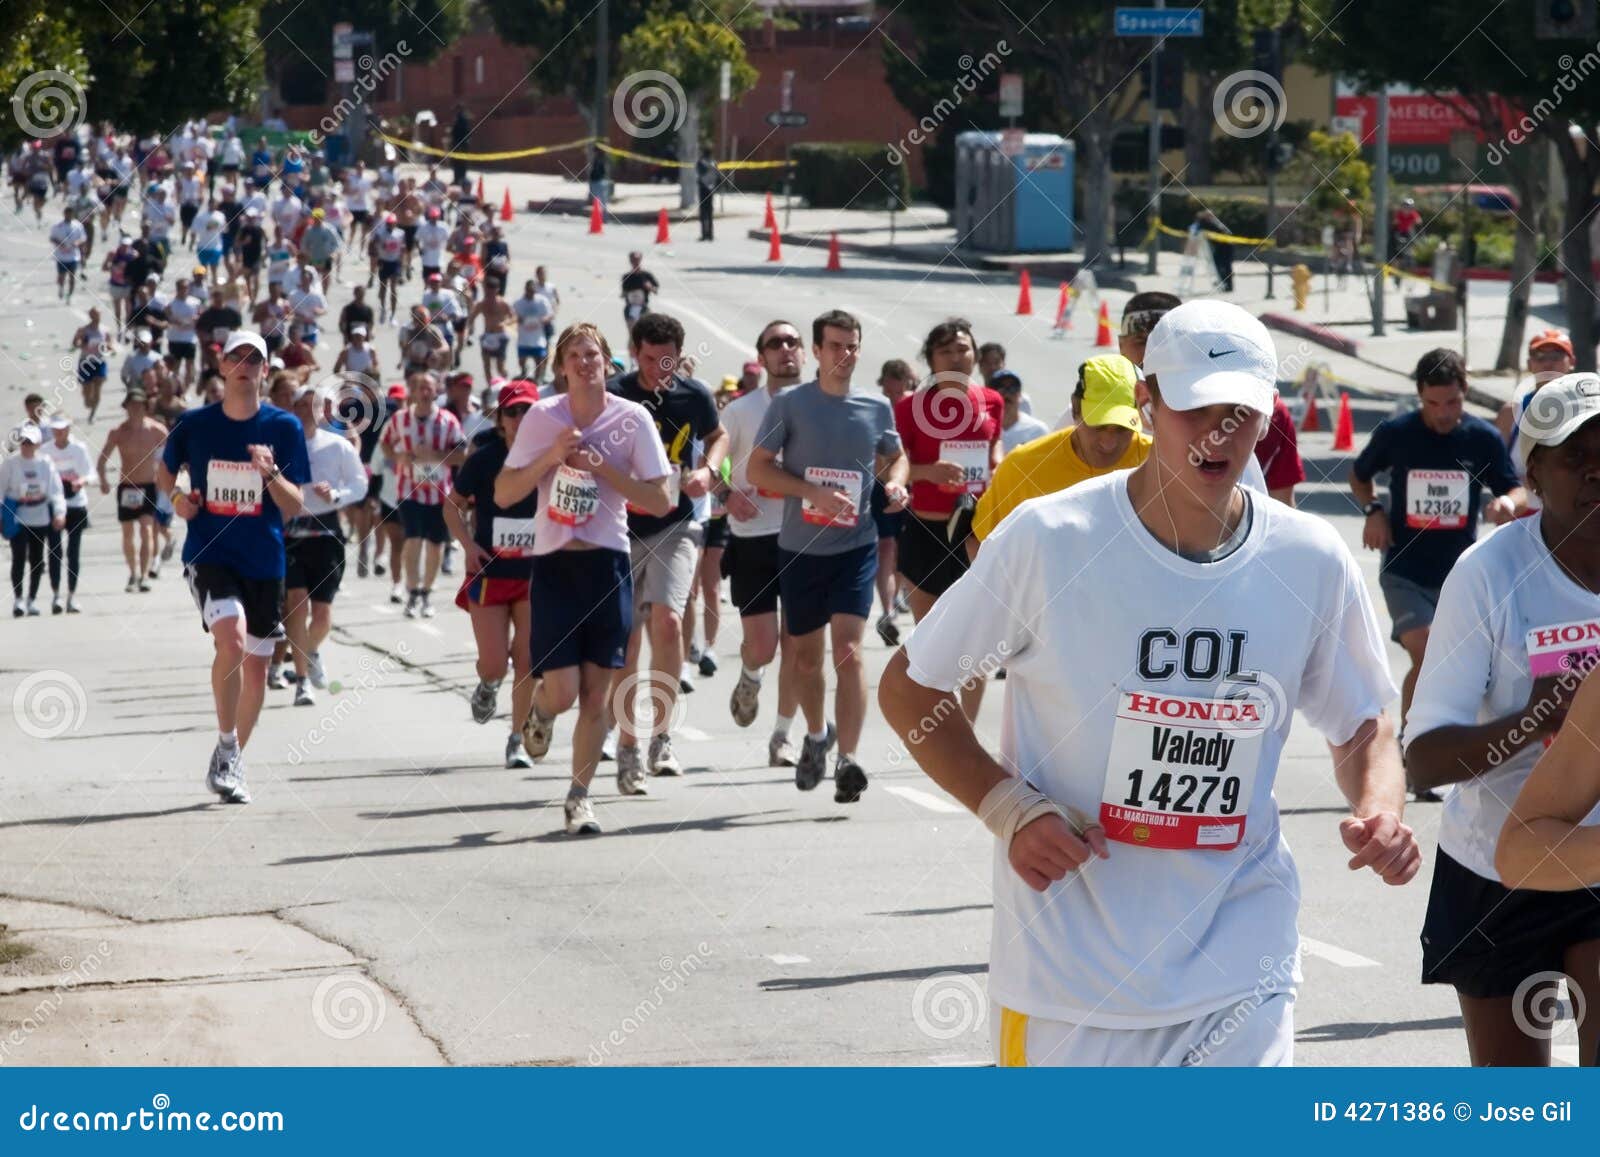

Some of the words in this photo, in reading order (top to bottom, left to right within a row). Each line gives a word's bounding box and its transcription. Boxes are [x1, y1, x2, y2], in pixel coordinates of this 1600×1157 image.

[808, 468, 859, 480] HONDA
[1412, 471, 1465, 480] HONDA
[214, 488, 256, 502] 18819
[1136, 627, 1262, 686] COL
[1126, 693, 1260, 722] HONDA
[1151, 726, 1235, 772] Valady
[1124, 769, 1241, 815] 14279
[1124, 810, 1165, 827] MARATHON
[1165, 816, 1180, 828] XXI
